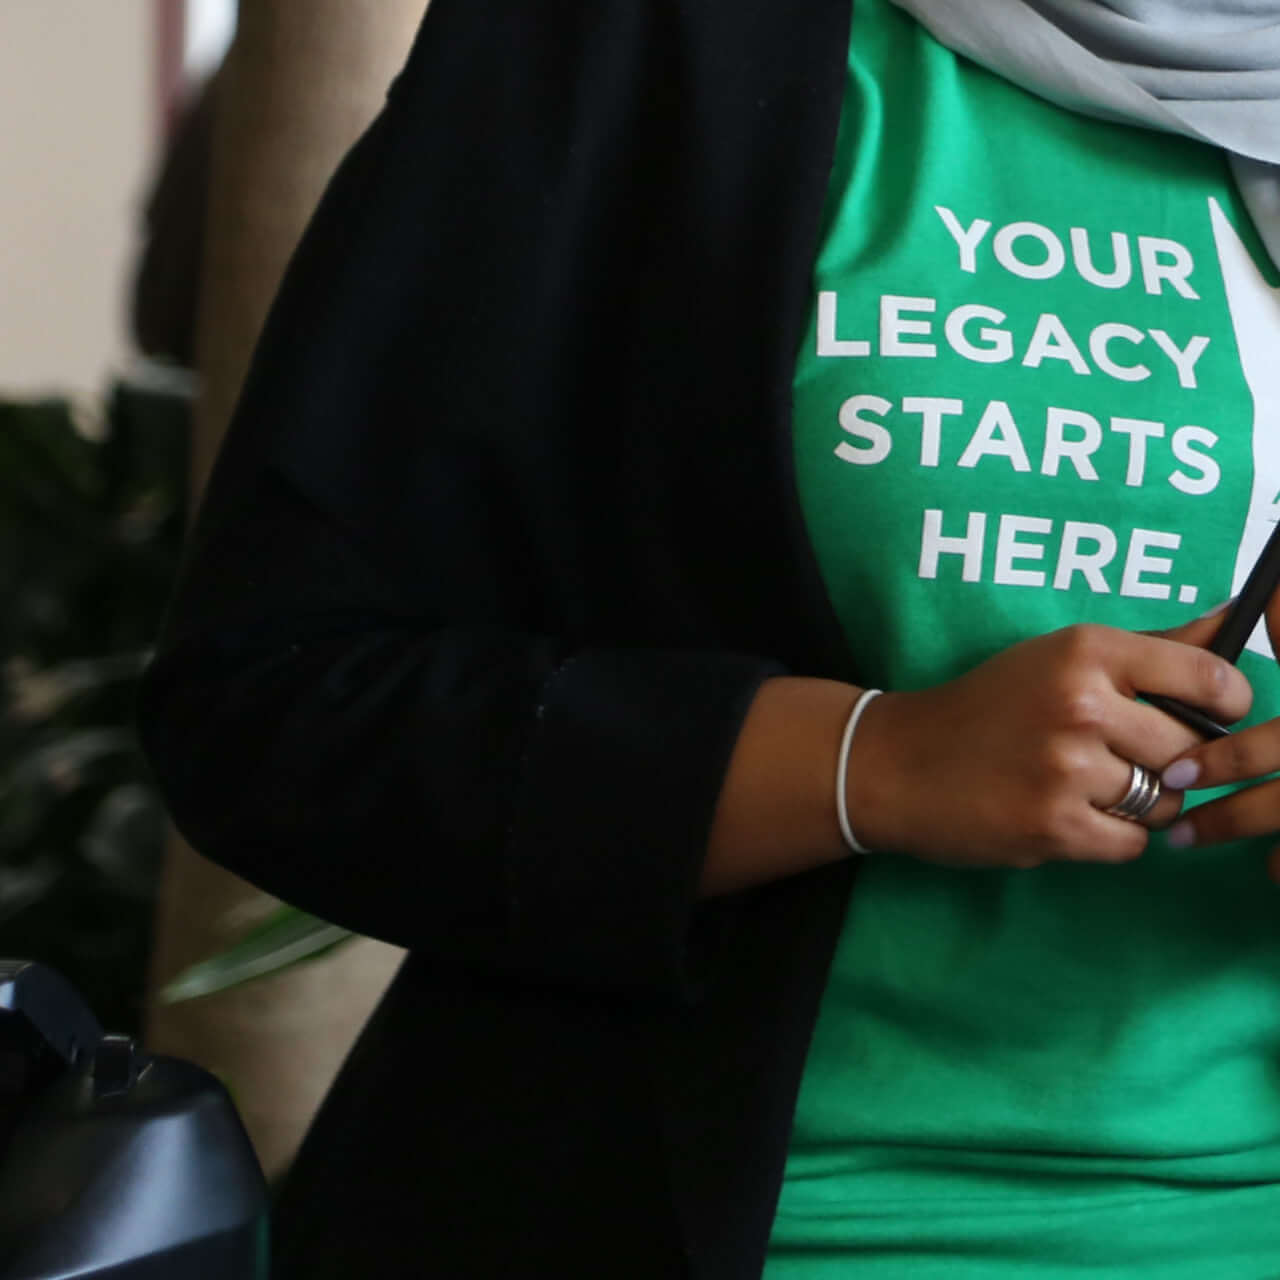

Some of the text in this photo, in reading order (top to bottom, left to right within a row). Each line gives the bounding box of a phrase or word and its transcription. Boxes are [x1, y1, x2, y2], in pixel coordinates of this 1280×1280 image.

[934, 206, 1201, 300] YOUR
[816, 291, 1211, 388] LEGACY
[834, 395, 1222, 495] STARTS
[917, 509, 1199, 604] HERE.
